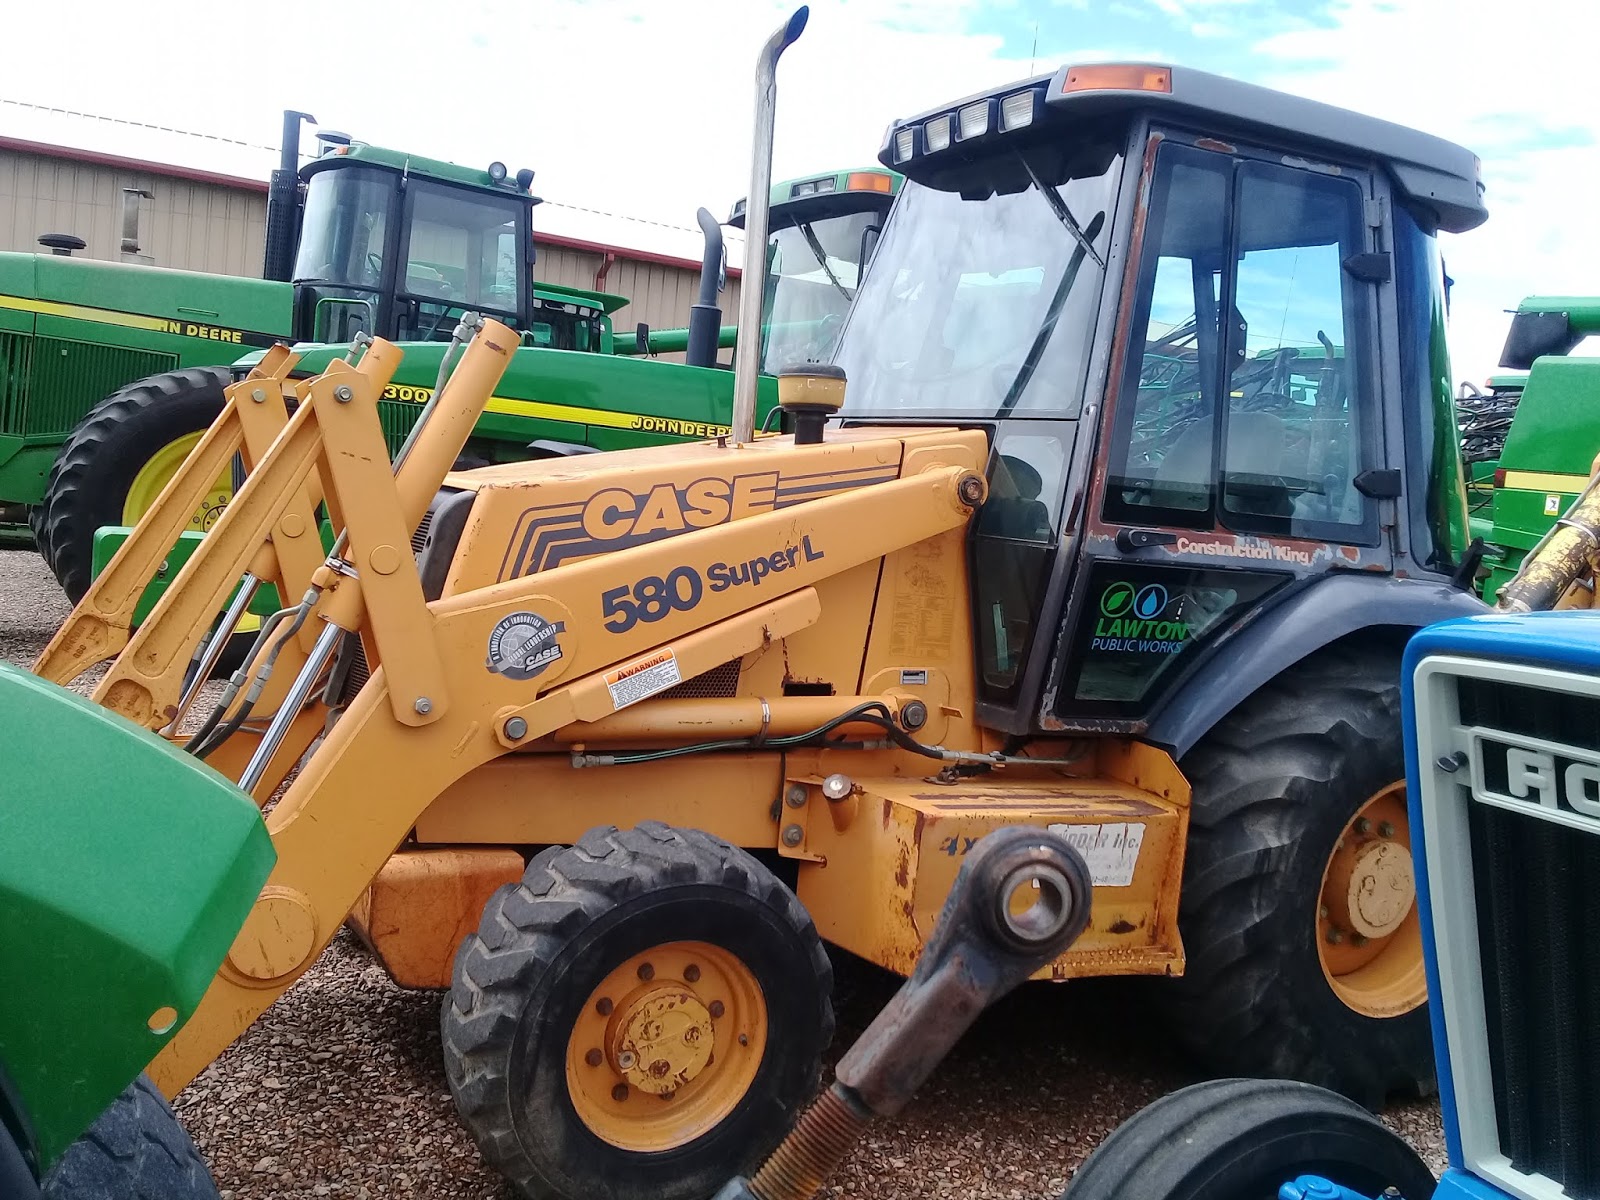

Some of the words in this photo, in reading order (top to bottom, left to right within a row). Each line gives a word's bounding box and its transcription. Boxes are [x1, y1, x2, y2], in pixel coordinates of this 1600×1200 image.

[186, 324, 242, 343] DEERE
[632, 417, 679, 434] JOHN
[583, 471, 780, 540] CASE
[1177, 537, 1273, 560] Construction
[1274, 545, 1309, 565] King
[601, 565, 703, 634] 580
[706, 545, 799, 593] Super
[802, 534, 825, 563] L
[490, 626, 505, 655] TRADITION
[502, 620, 511, 629] OF
[510, 615, 542, 628] INNOVATION
[1095, 618, 1189, 640] LAWTON
[507, 646, 527, 663] GLOBAL
[524, 623, 557, 651] LEADERSHIP
[1091, 638, 1137, 652] PUBLIC
[1138, 640, 1183, 654] WORKS
[526, 645, 561, 666] CASE
[626, 655, 665, 677] WARNING
